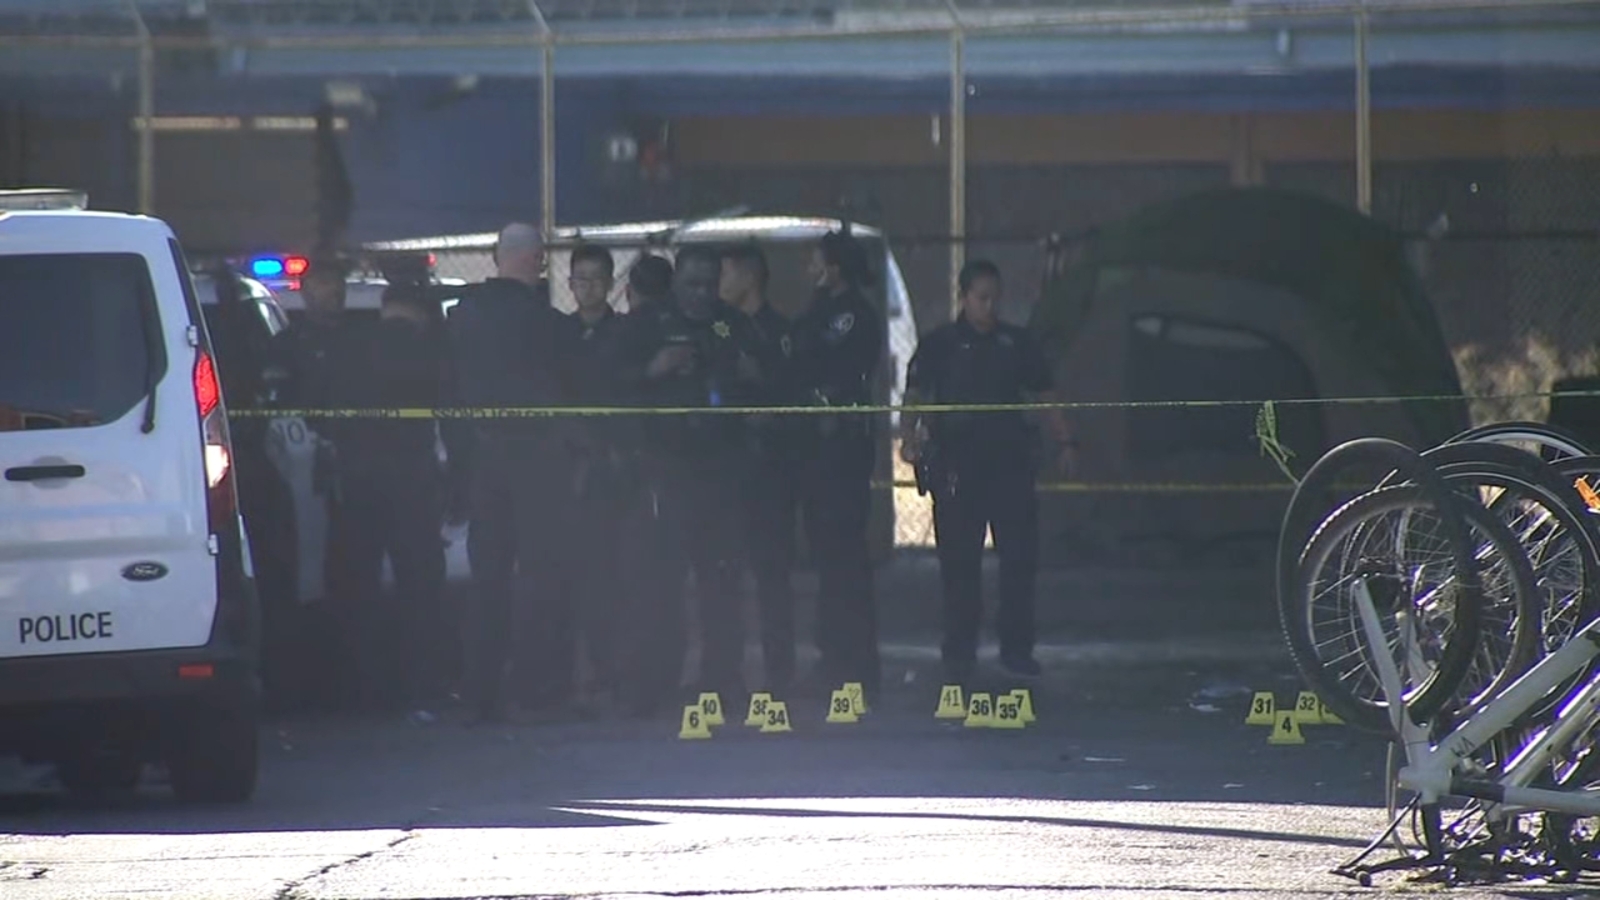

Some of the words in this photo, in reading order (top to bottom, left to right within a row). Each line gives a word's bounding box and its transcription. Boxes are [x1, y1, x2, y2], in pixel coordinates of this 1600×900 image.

[18, 610, 114, 645] POLICE
[833, 697, 850, 713] 39
[943, 688, 960, 708] 41
[1014, 694, 1025, 709] 7
[1254, 698, 1272, 715] 31
[1299, 695, 1316, 711] 32
[970, 699, 990, 716] 36
[999, 703, 1018, 720] 35
[689, 710, 700, 729] 6
[767, 709, 786, 726] 34
[1281, 715, 1293, 734] 4
